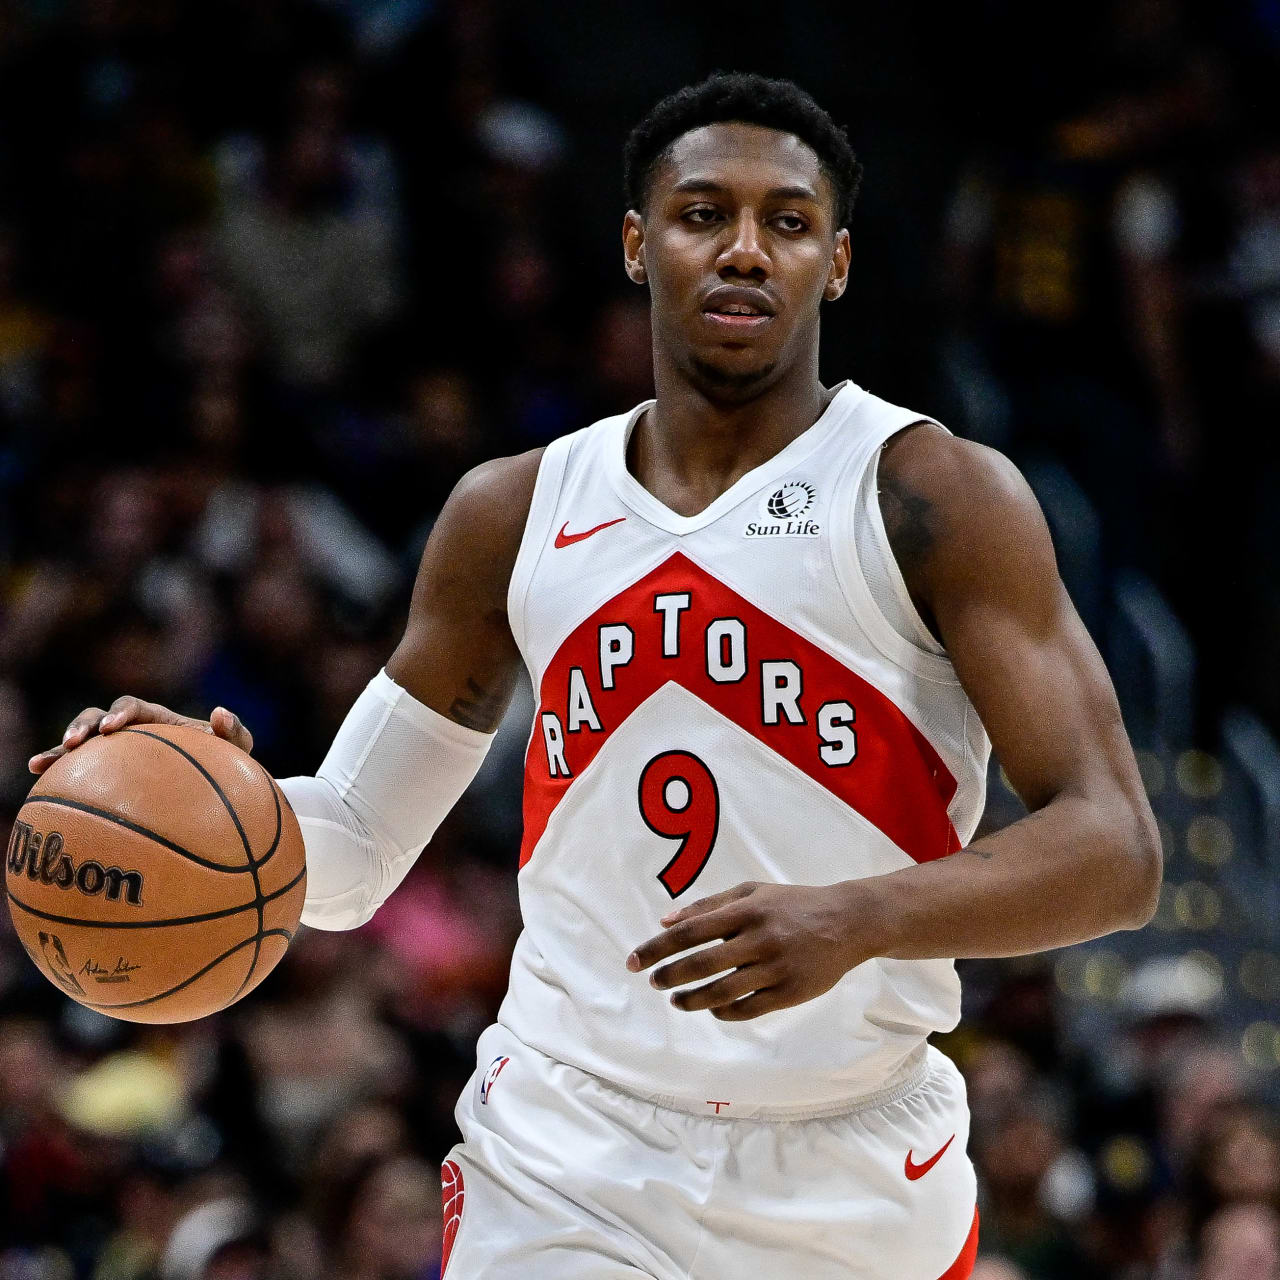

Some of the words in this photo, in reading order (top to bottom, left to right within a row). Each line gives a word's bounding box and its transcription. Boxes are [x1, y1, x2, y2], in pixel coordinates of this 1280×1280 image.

[745, 522, 781, 537] Sun
[784, 519, 820, 536] Life
[541, 592, 858, 778] RAPTORS
[637, 749, 721, 900] 9
